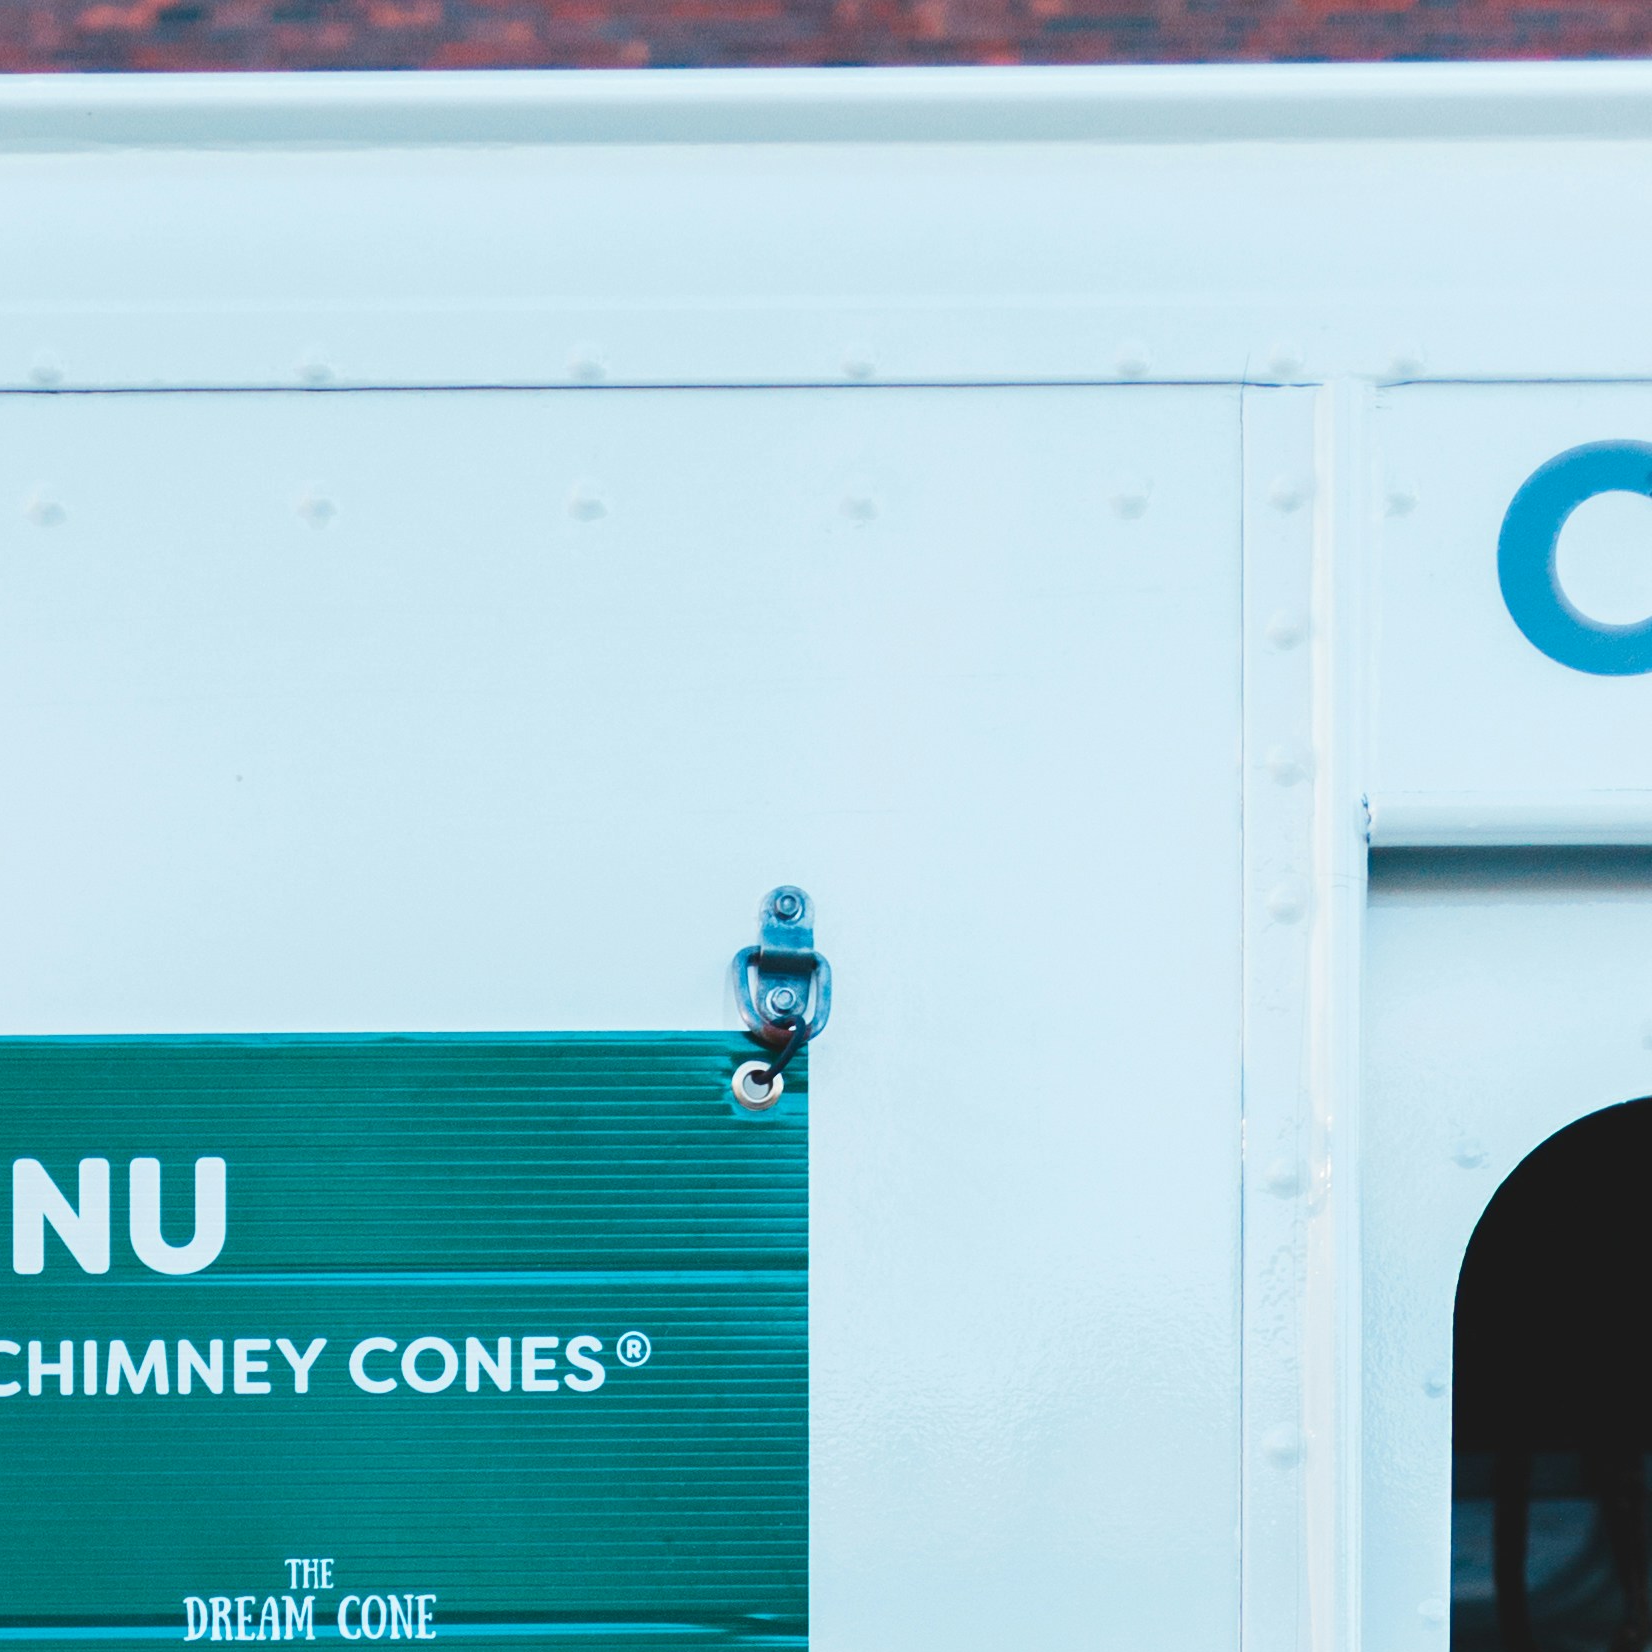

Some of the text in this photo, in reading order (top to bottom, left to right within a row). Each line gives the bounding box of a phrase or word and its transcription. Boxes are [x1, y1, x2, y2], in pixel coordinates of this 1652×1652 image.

[284, 1558, 334, 1589] THE
[183, 1594, 437, 1641] DREAM CONE
